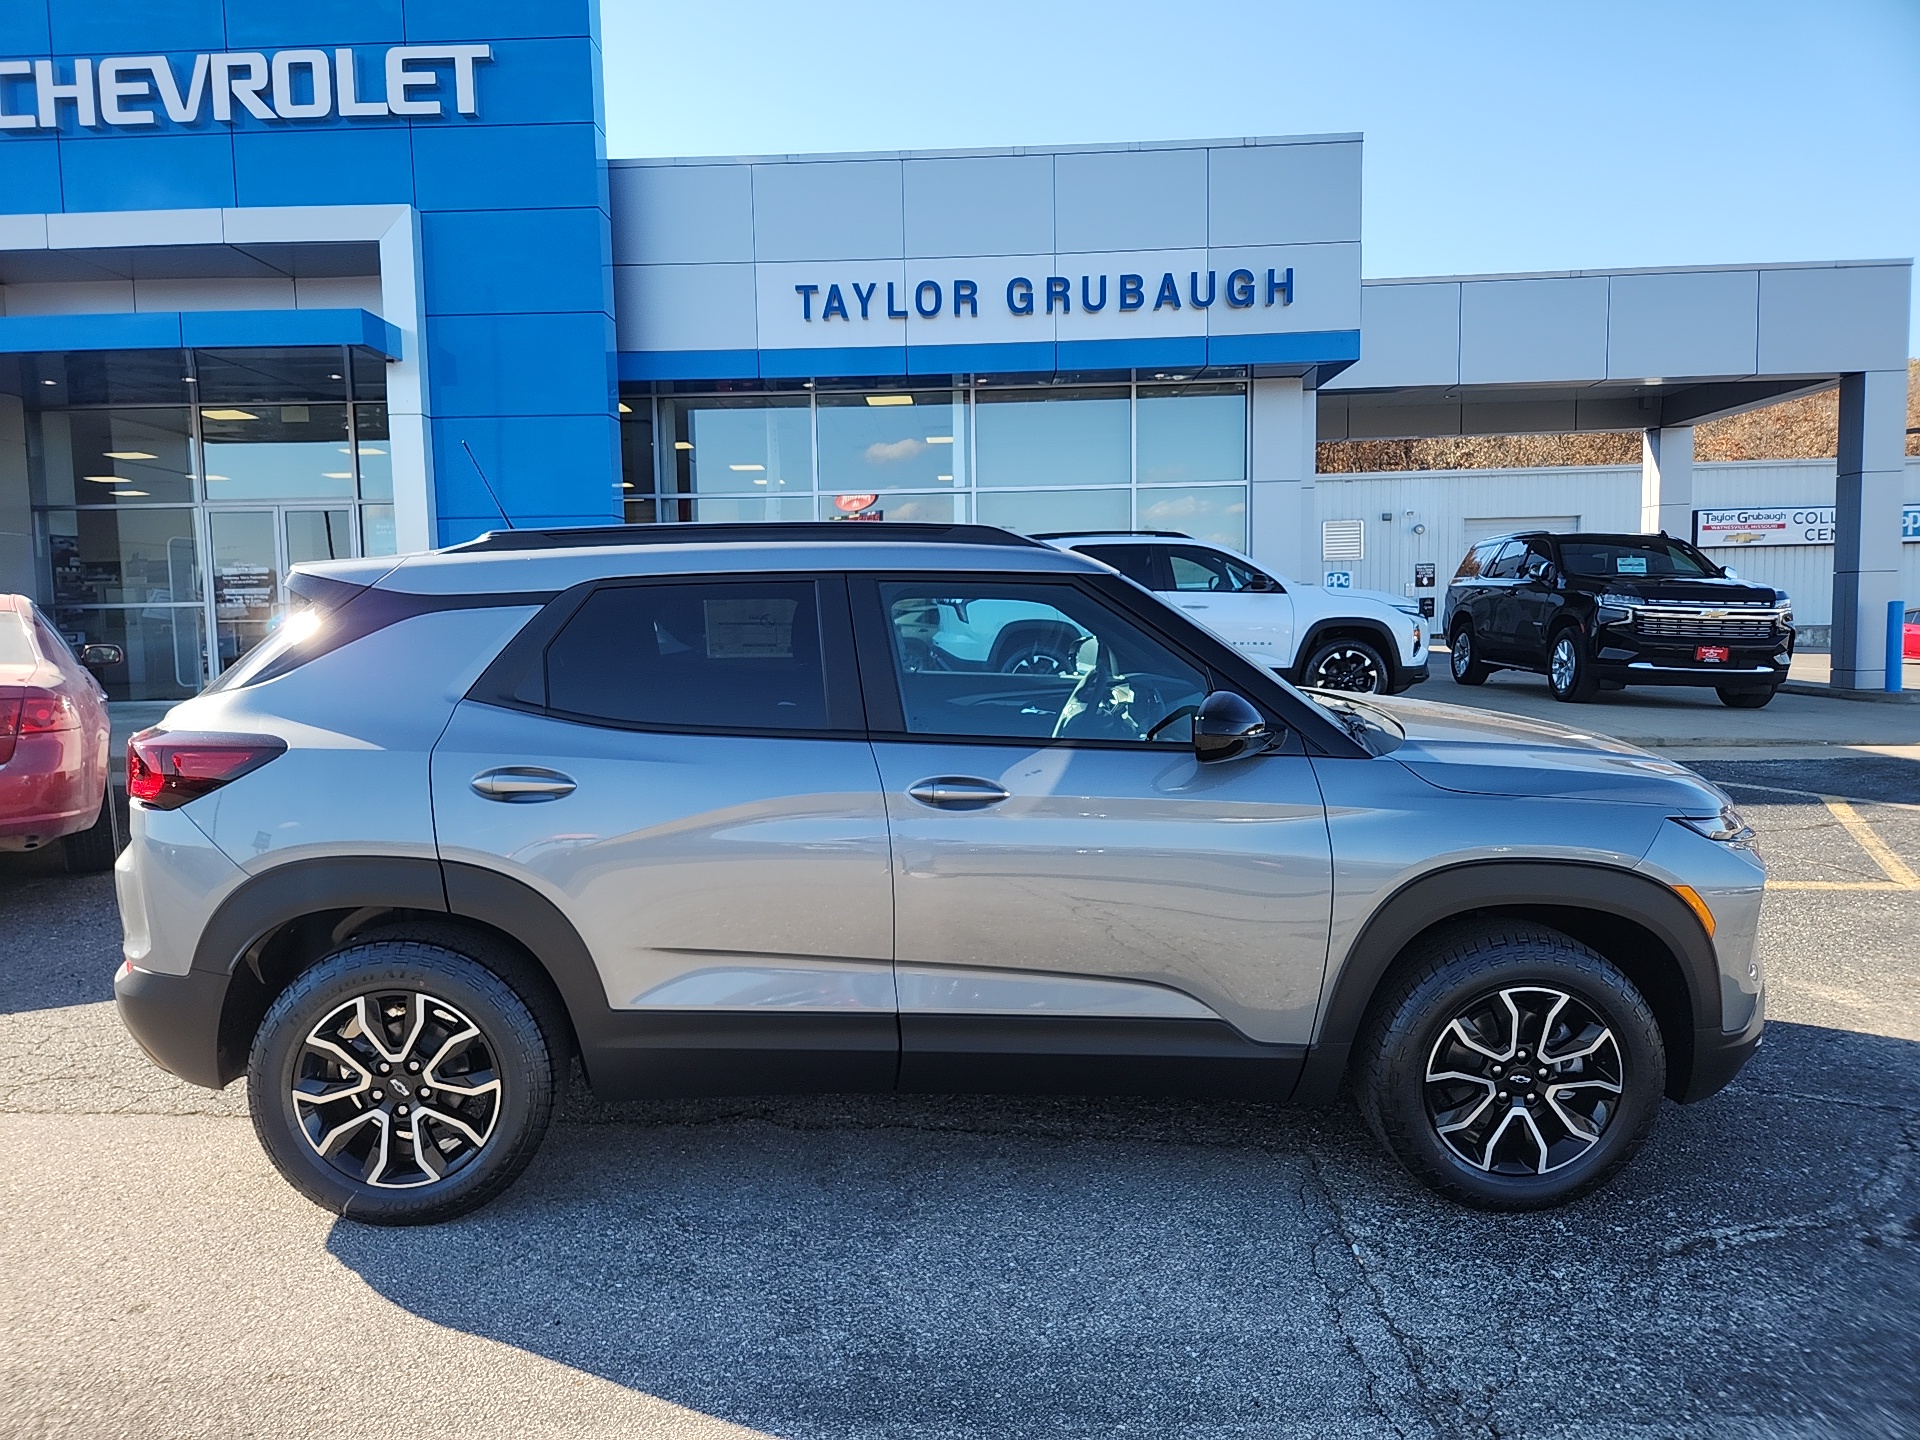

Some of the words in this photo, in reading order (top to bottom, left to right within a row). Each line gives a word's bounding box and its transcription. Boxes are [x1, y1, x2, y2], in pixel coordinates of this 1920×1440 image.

[0, 44, 492, 129] CHEVROLET
[795, 279, 979, 322] TAYLOR
[1006, 267, 1296, 316] GRUBAUGH
[1703, 513, 1736, 524] Taylor
[1737, 512, 1787, 523] Grubaugh
[1328, 573, 1349, 589] PPG
